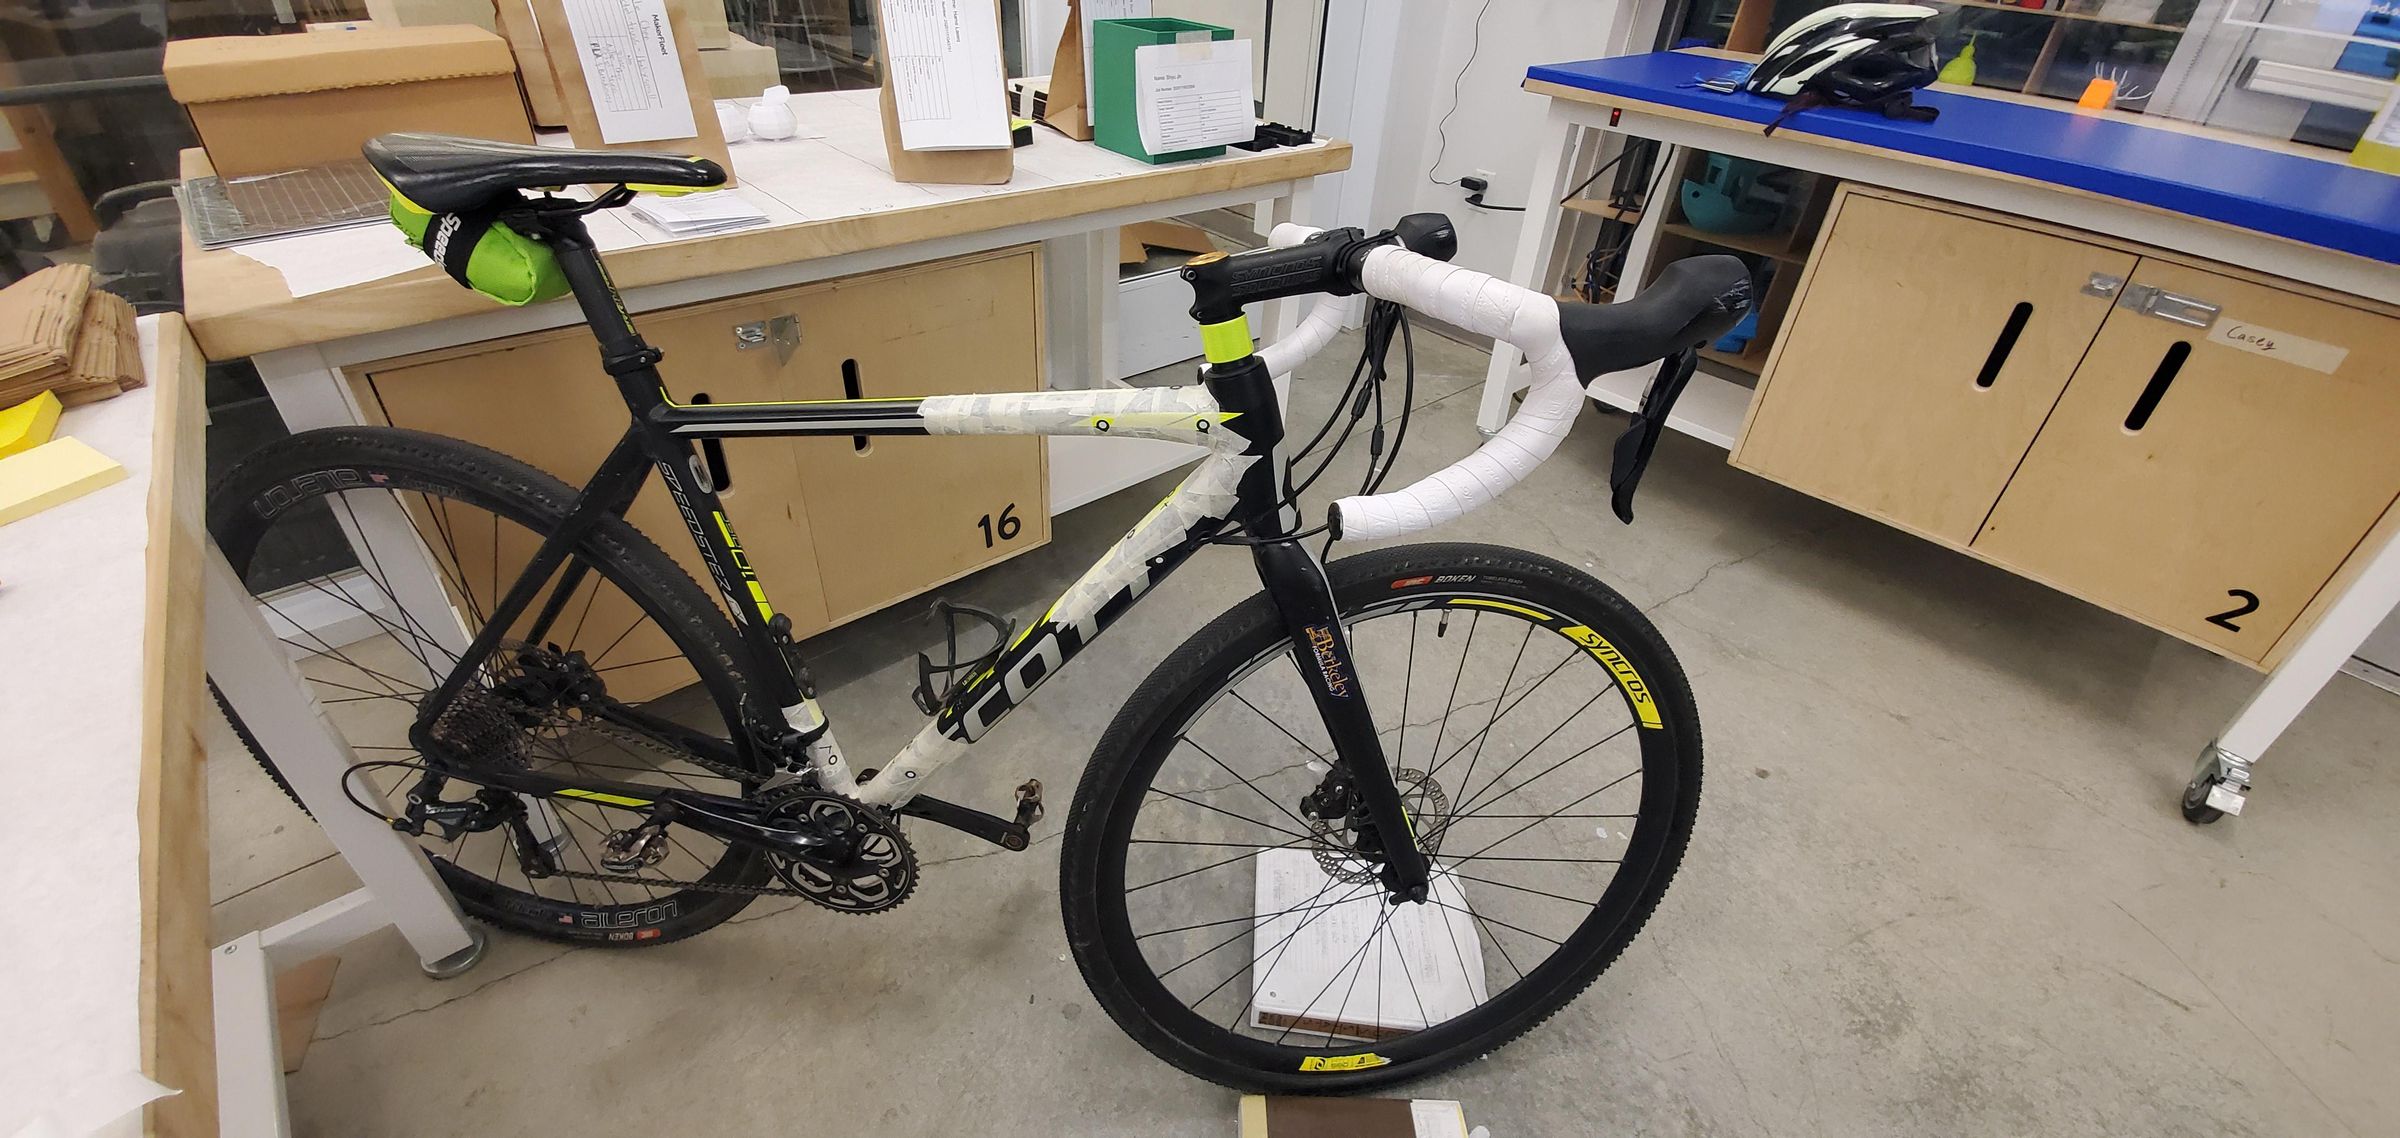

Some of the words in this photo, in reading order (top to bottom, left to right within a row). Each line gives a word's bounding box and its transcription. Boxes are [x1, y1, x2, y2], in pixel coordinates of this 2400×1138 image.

[652, 14, 669, 56] MakerFleet
[2226, 325, 2276, 351] Casey
[661, 460, 732, 592] SPEEDSTER
[978, 502, 1021, 549] 16
[1434, 575, 1476, 584] BOKEN
[2205, 589, 2260, 633] 2
[1316, 633, 1349, 698] Berkeley
